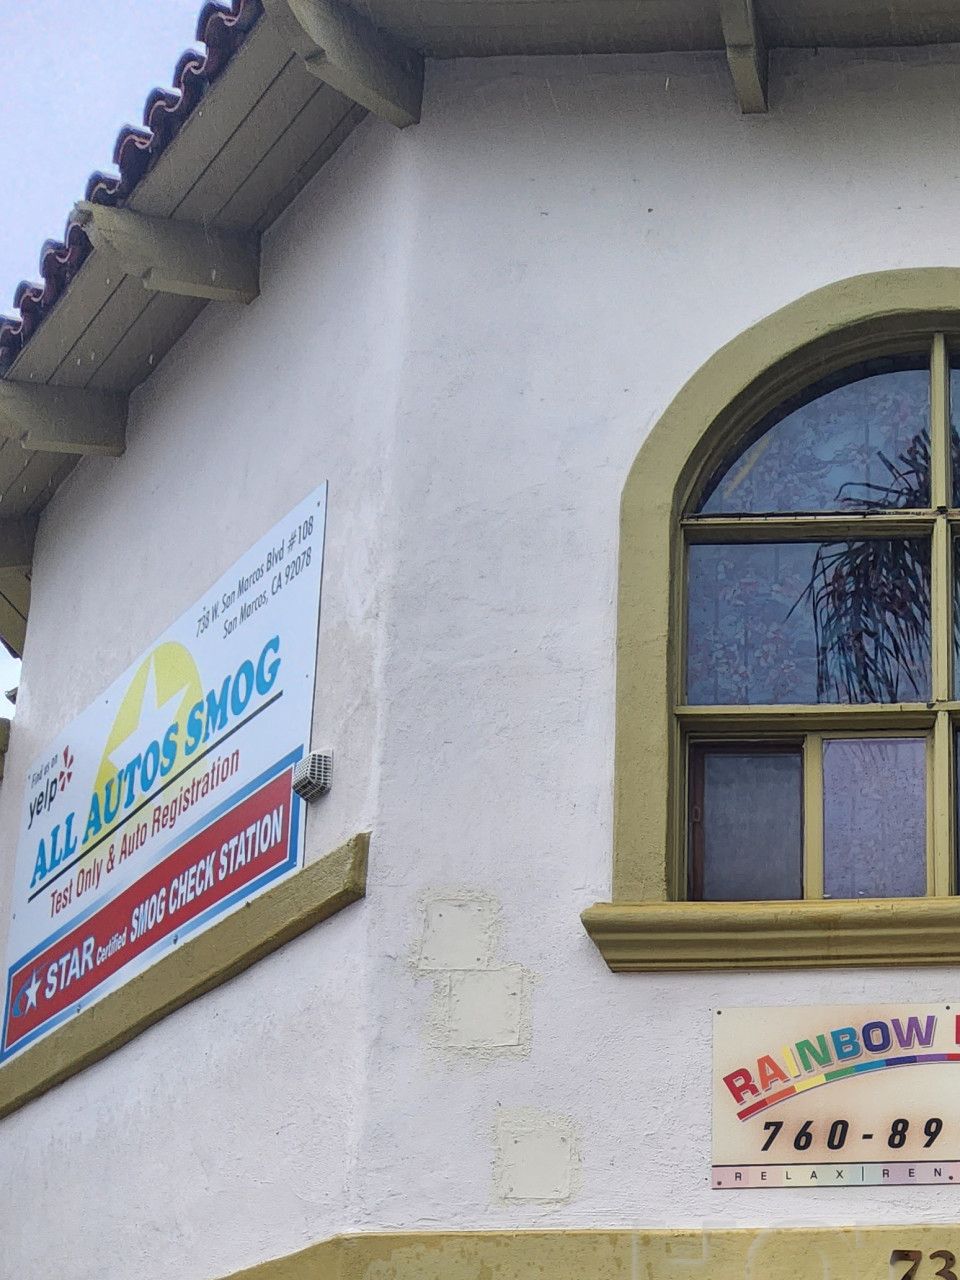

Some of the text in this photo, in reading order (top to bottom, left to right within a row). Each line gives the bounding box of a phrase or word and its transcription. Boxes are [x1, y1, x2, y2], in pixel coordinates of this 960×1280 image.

[196, 611, 209, 637] 738
[222, 591, 235, 613] San
[237, 564, 264, 598] Marcos
[266, 539, 284, 572] Blvd
[223, 616, 237, 639] San
[271, 571, 283, 596] CA
[285, 546, 312, 585] 92078
[27, 778, 58, 830] yelp
[30, 635, 281, 888] ALL AUTOS SMOG
[50, 749, 240, 918] Test Only & Auto Registration
[45, 804, 284, 999] STAR Certified SMOG CHECK STATION
[722, 1014, 938, 1105] RAINBOW
[734, 1169, 844, 1182] RELAX
